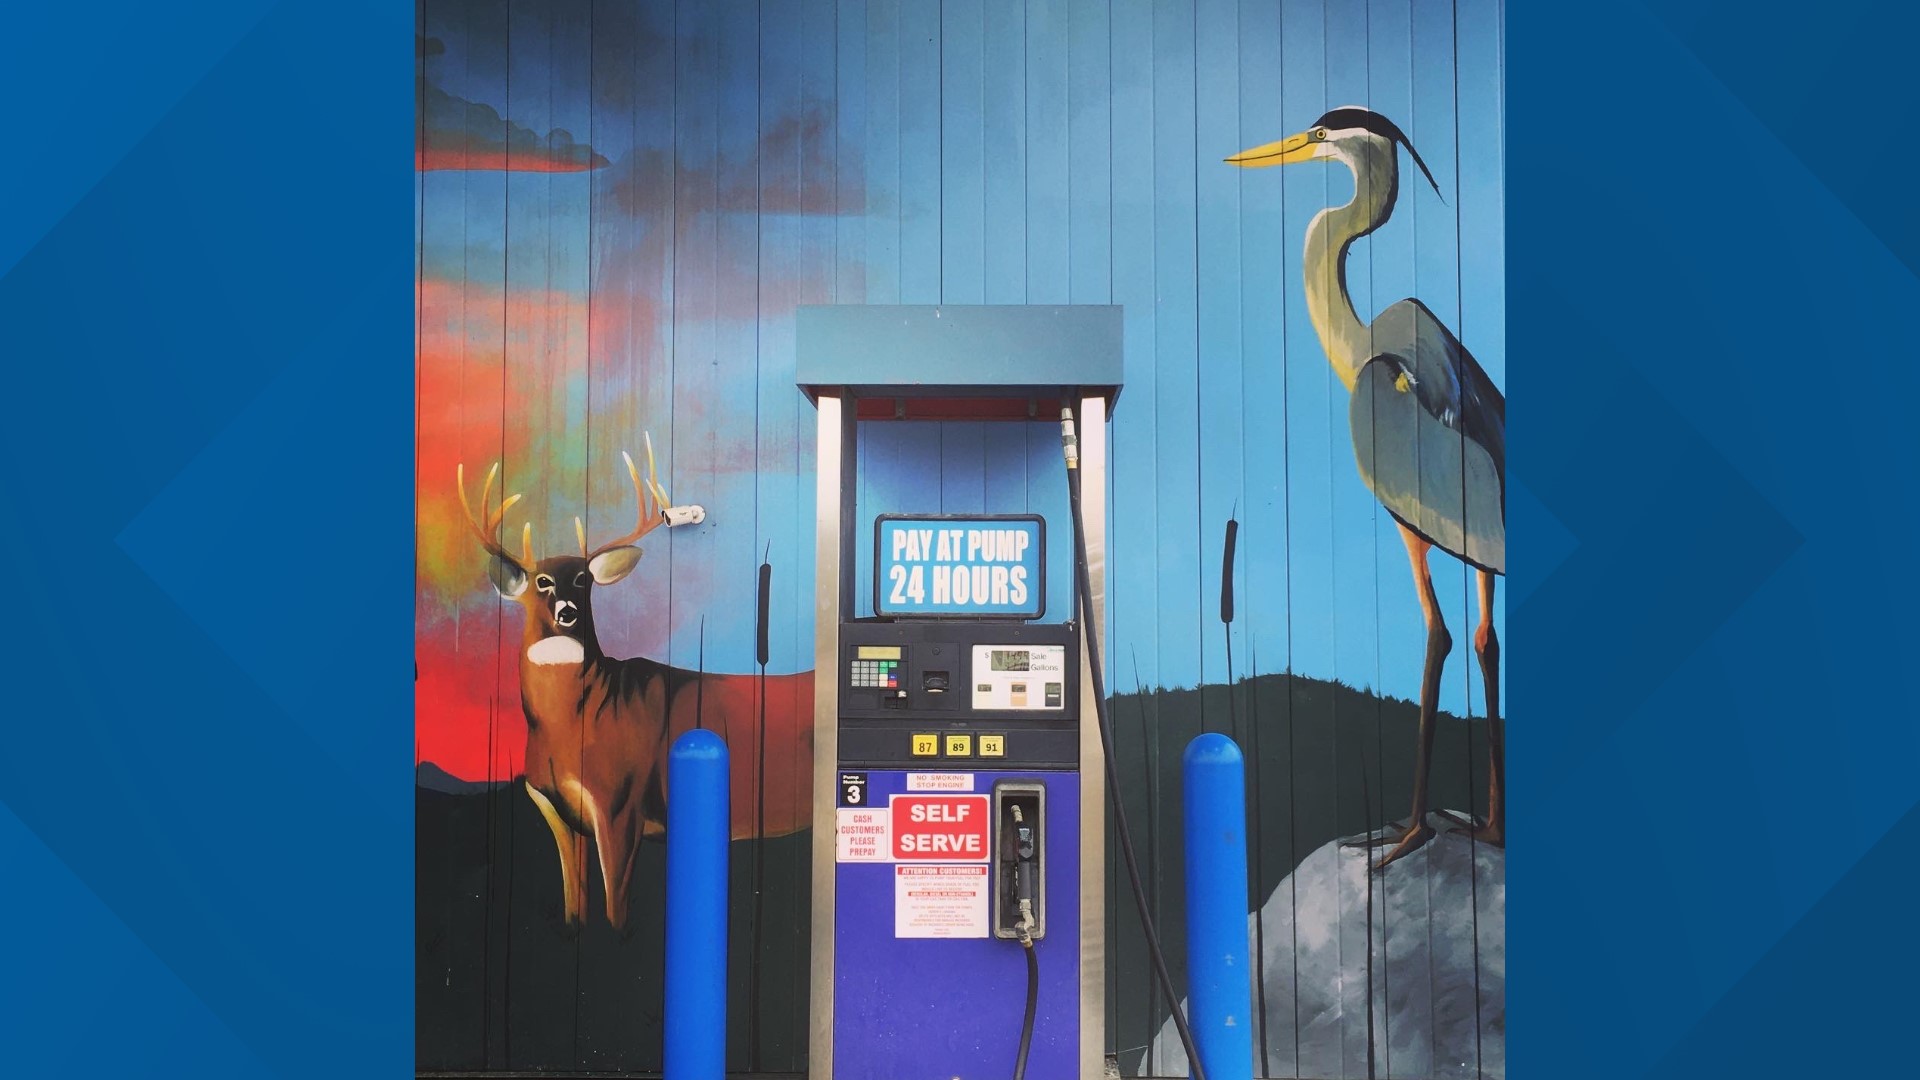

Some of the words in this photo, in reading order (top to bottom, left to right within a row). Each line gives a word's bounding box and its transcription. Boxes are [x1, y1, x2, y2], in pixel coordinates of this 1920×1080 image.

[893, 529, 933, 561] PAY
[936, 529, 964, 561] AT
[968, 530, 1029, 562] PUMP
[889, 565, 925, 604] 24
[933, 565, 1028, 605] HOURS
[918, 742, 932, 753] 87
[952, 743, 965, 752] 89
[986, 743, 998, 752] 91
[847, 785, 861, 804] 3
[910, 804, 971, 822] SELF
[853, 815, 873, 823] CASH
[841, 826, 885, 834] CUSTOMERS
[850, 837, 876, 845] PLEASE
[900, 834, 981, 852] SERVE
[849, 848, 876, 856] PREPAY
[902, 867, 938, 875] ATTENTION
